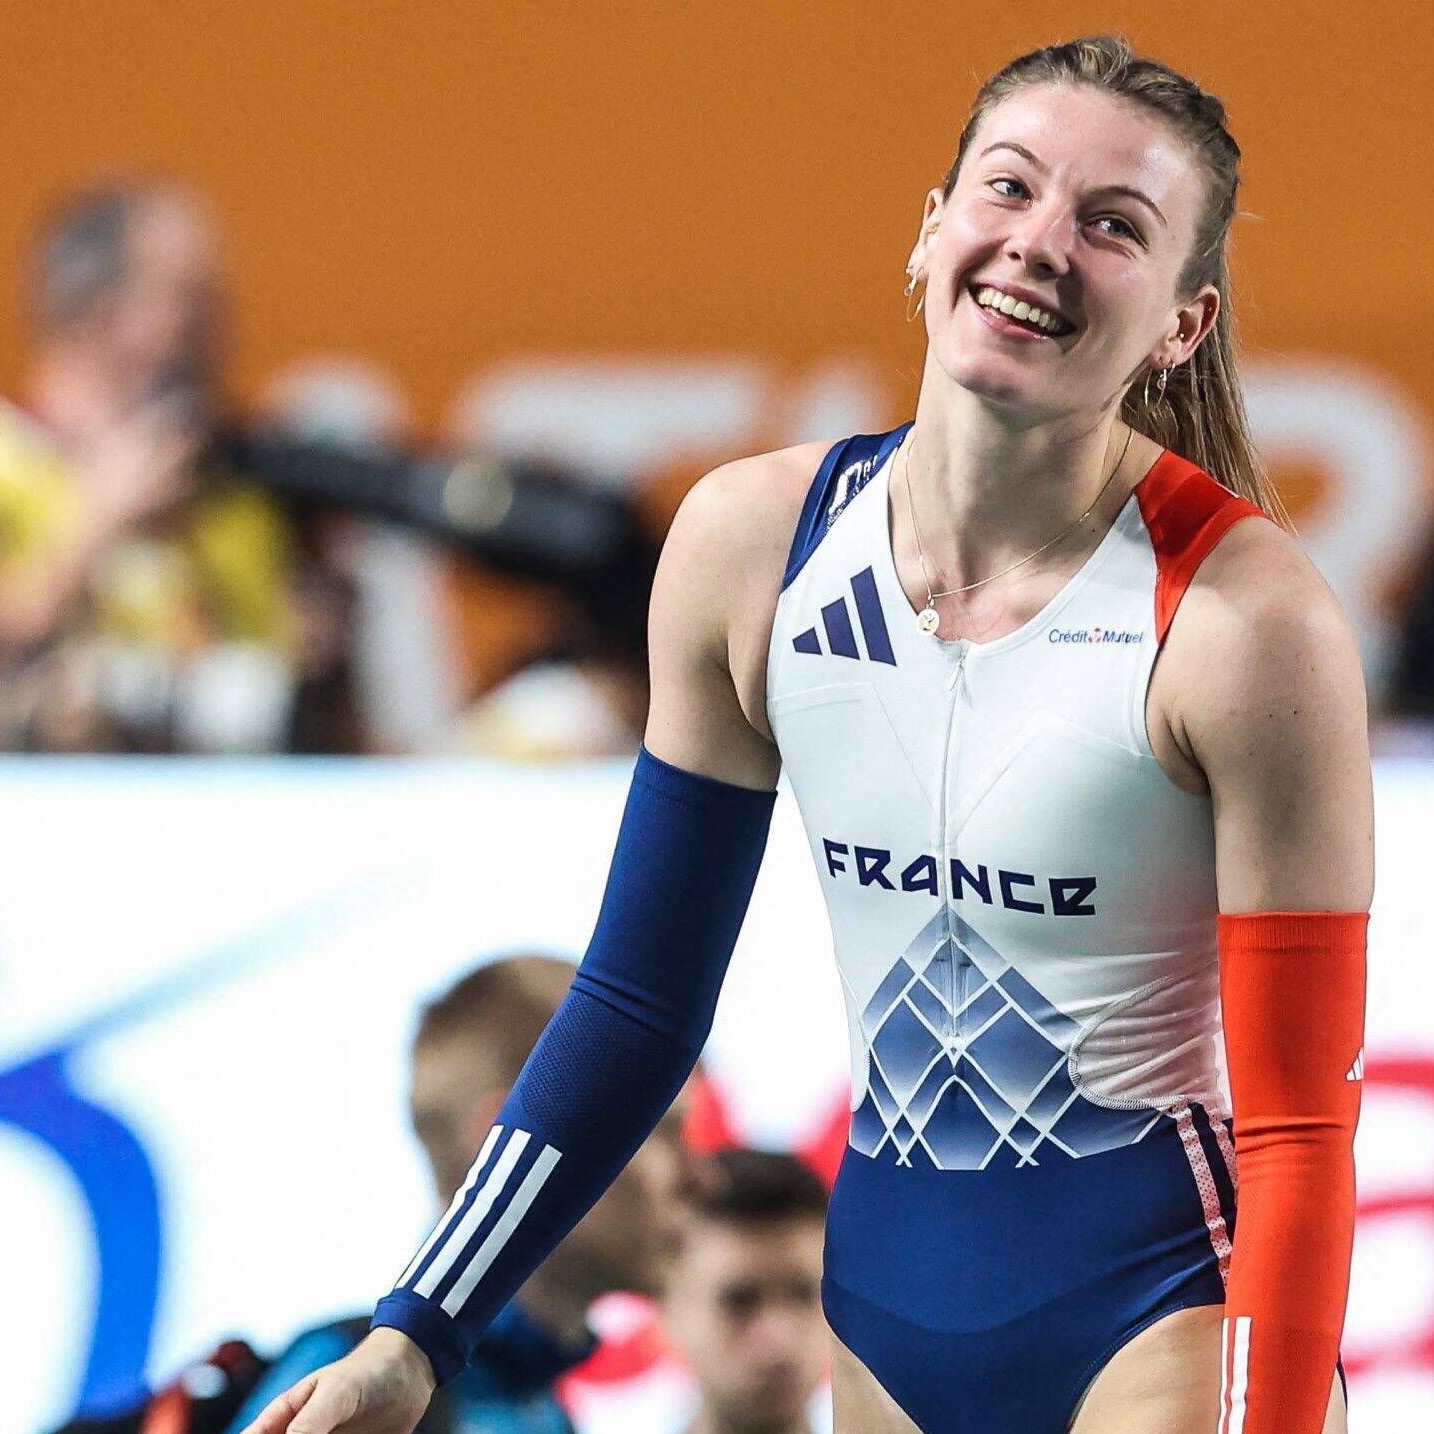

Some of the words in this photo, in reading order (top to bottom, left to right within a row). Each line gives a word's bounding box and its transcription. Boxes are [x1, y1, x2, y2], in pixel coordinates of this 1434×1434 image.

[1048, 628, 1088, 644] Crédit
[1103, 629, 1144, 643] Mutuel
[823, 838, 1098, 916] FRANCE
